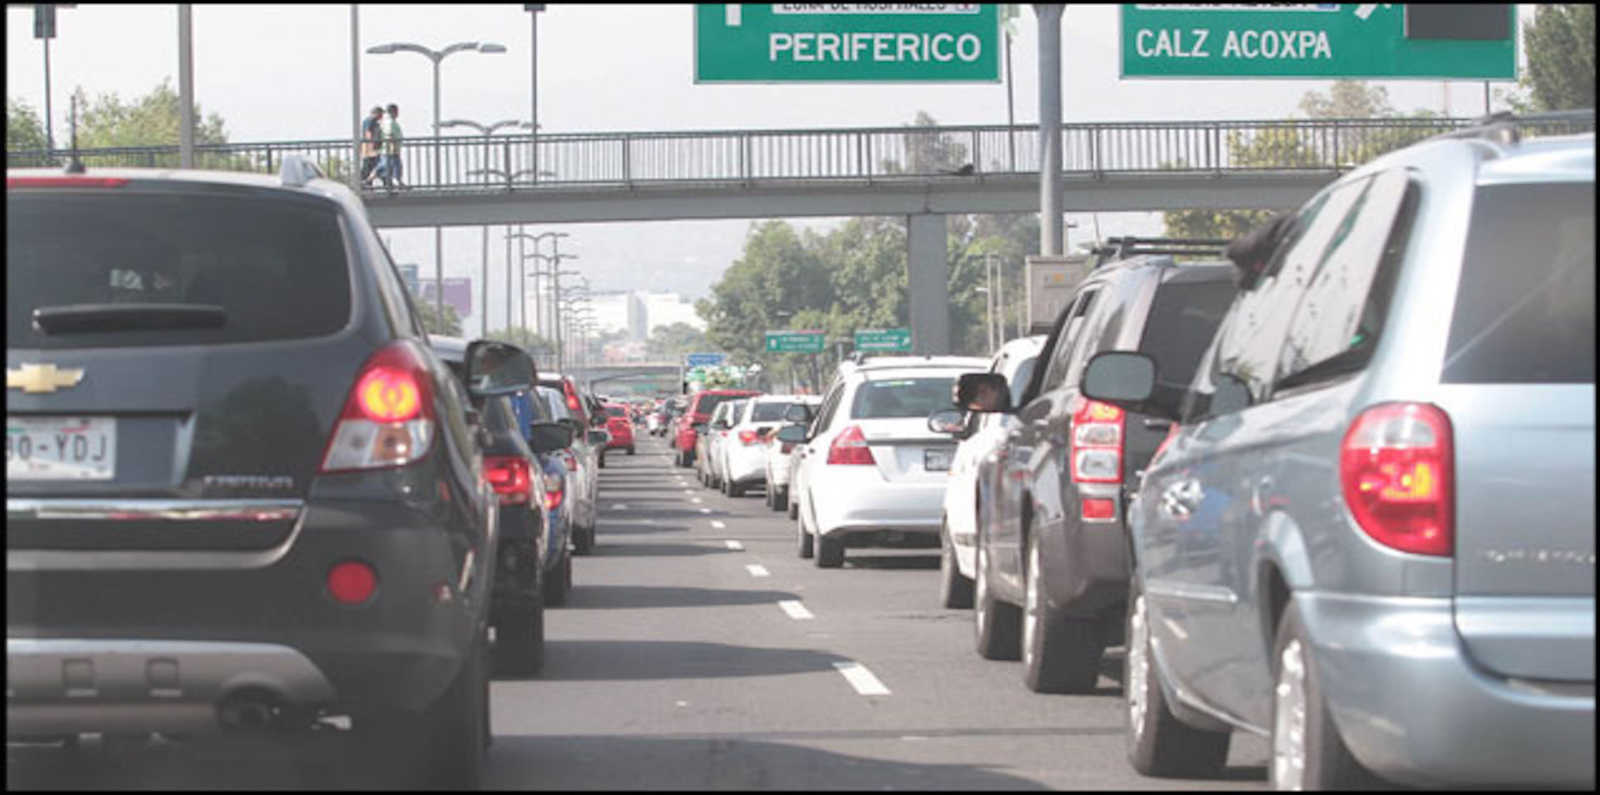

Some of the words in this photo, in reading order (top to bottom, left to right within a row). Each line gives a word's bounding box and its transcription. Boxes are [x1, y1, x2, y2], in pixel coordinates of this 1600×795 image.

[769, 33, 981, 62] PERIFERICO
[1136, 29, 1210, 57] CALZ
[1222, 30, 1332, 59] ACOXPA
